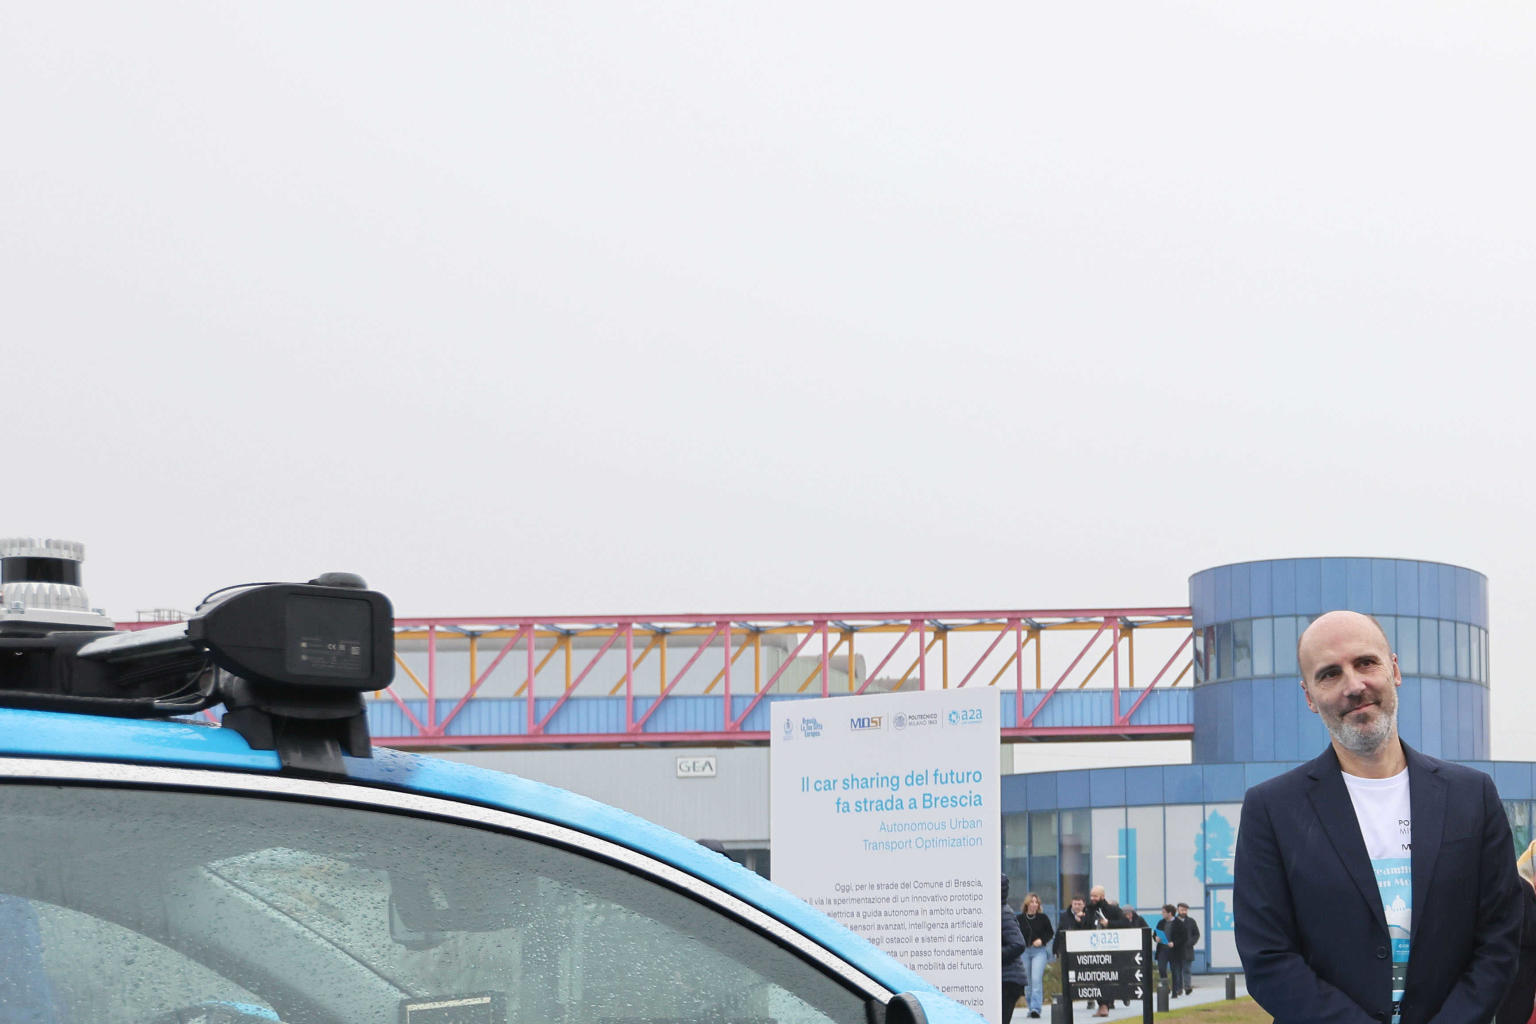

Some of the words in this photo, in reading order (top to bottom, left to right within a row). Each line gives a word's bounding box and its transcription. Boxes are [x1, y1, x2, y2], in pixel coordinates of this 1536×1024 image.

[961, 708, 983, 720] a2a
[679, 760, 714, 772] GEA
[801, 775, 809, 792] Il
[814, 779, 838, 792] car
[842, 772, 900, 791] sharing
[904, 769, 929, 786] del
[933, 768, 983, 784] futuro
[836, 797, 850, 813] fa
[854, 794, 904, 812] strada
[908, 797, 917, 810] a
[922, 790, 983, 808] Brescia
[879, 820, 946, 833] Autonomous
[949, 818, 983, 830] Urban
[863, 839, 912, 852] Transport
[915, 835, 983, 851] Optimization
[855, 883, 867, 892] per
[877, 882, 899, 890] strade
[900, 881, 911, 889] del
[913, 880, 944, 889] Comune
[945, 880, 953, 888] di
[1077, 954, 1112, 965] VISITATORI
[1077, 971, 1119, 981] AUDITORIUM
[1078, 988, 1102, 998] USCITA
